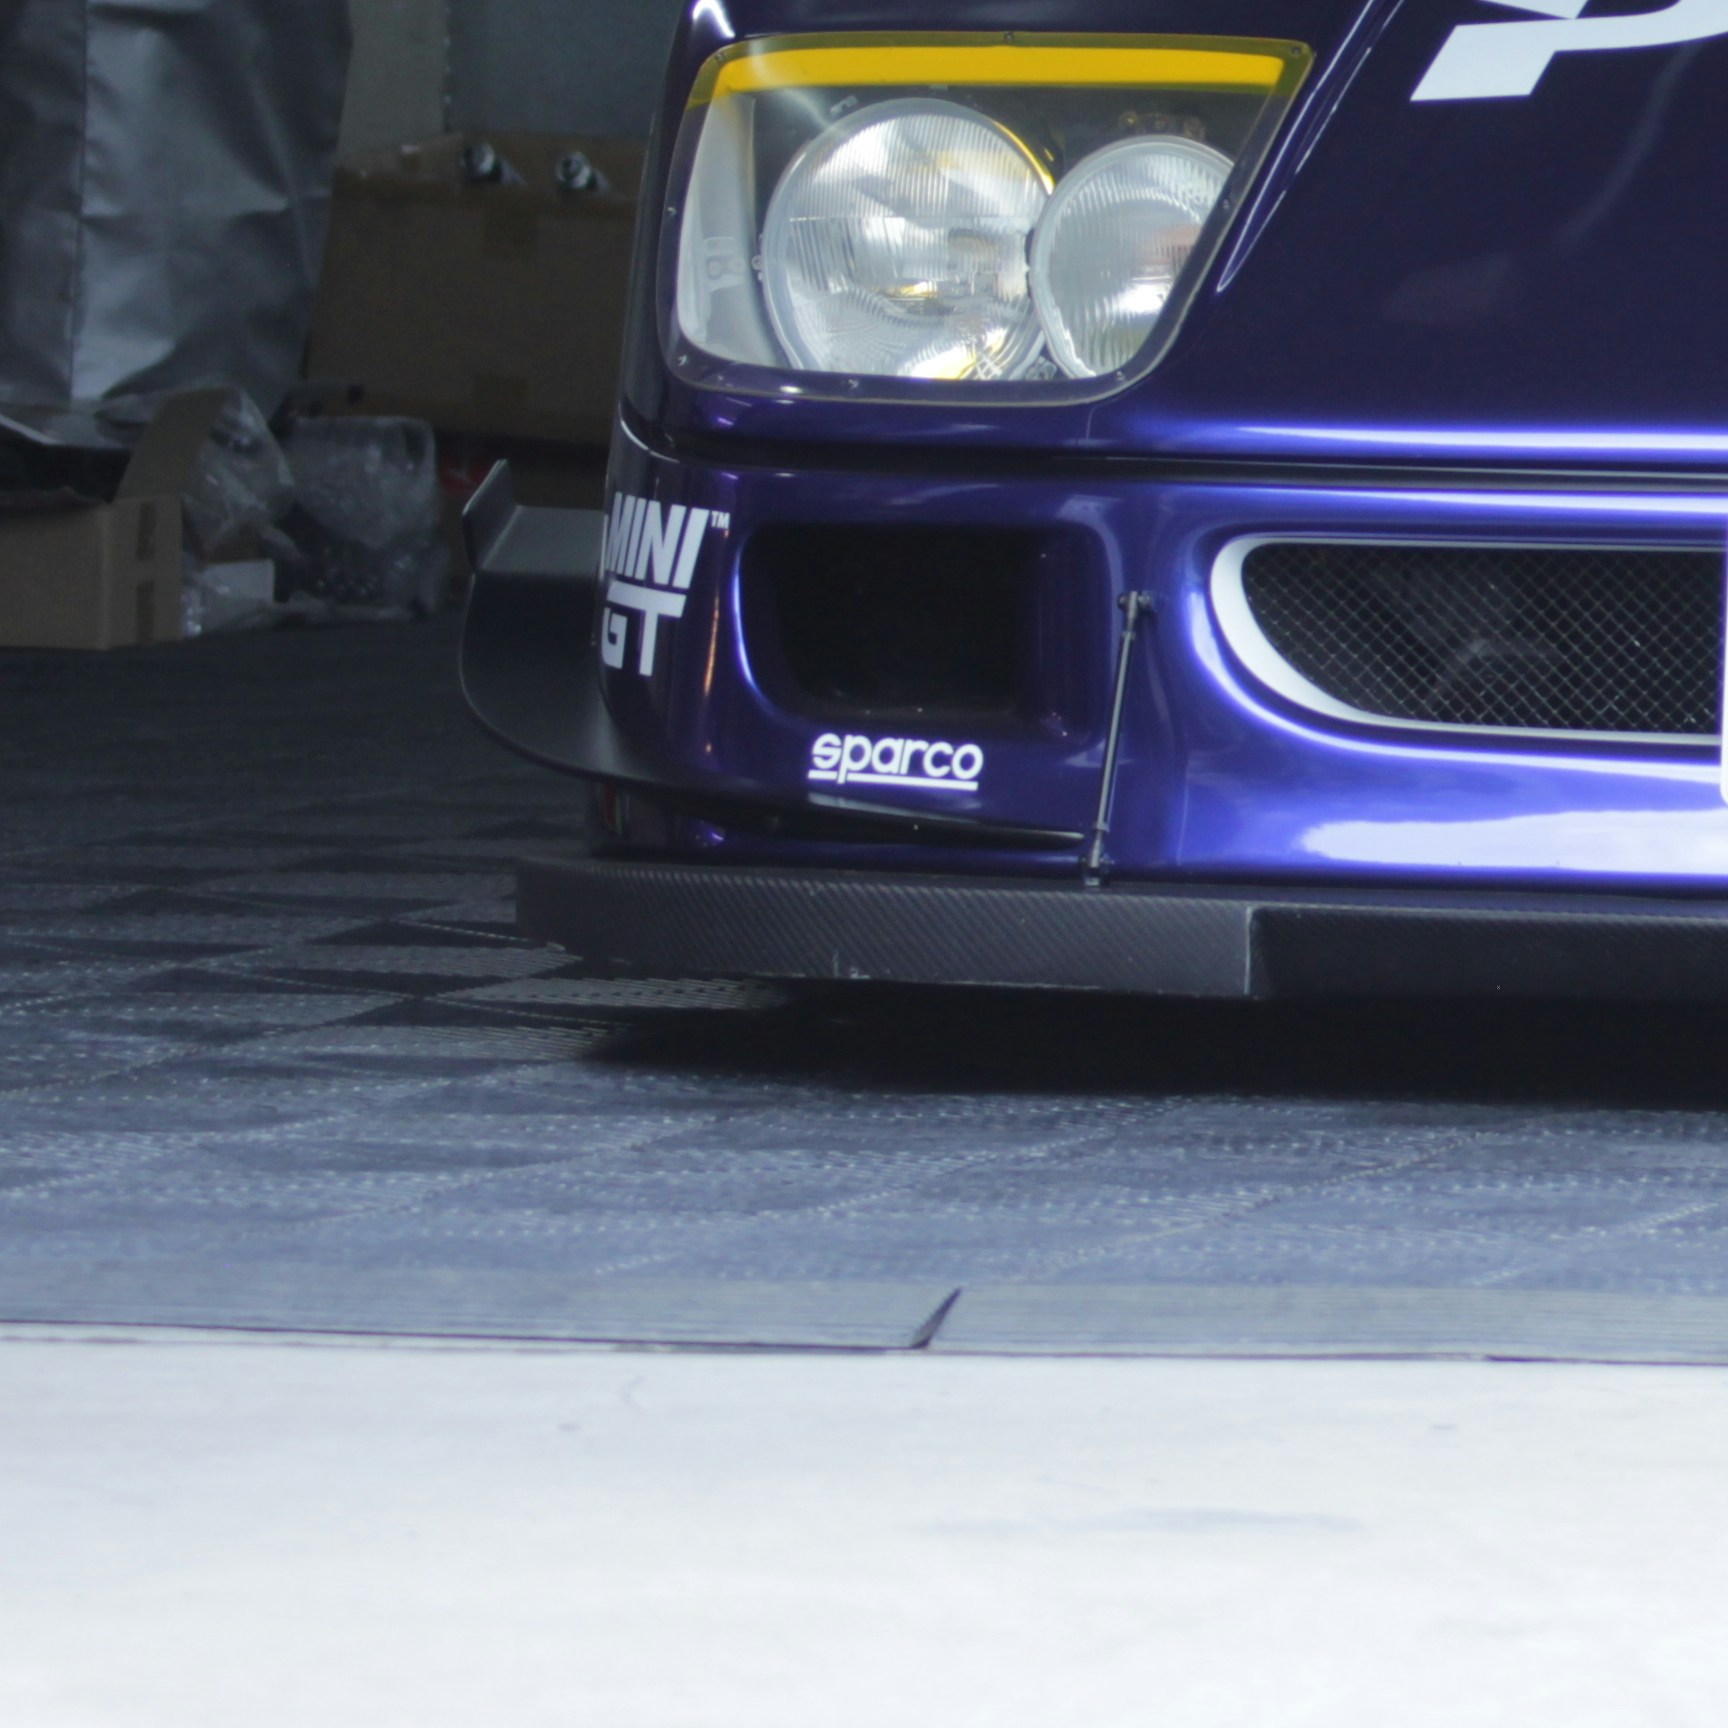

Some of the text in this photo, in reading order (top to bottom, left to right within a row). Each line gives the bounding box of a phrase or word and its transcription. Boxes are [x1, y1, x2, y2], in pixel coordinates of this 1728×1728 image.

[604, 491, 709, 590] MINI
[601, 579, 687, 677] GT
[807, 732, 984, 791] sparco
